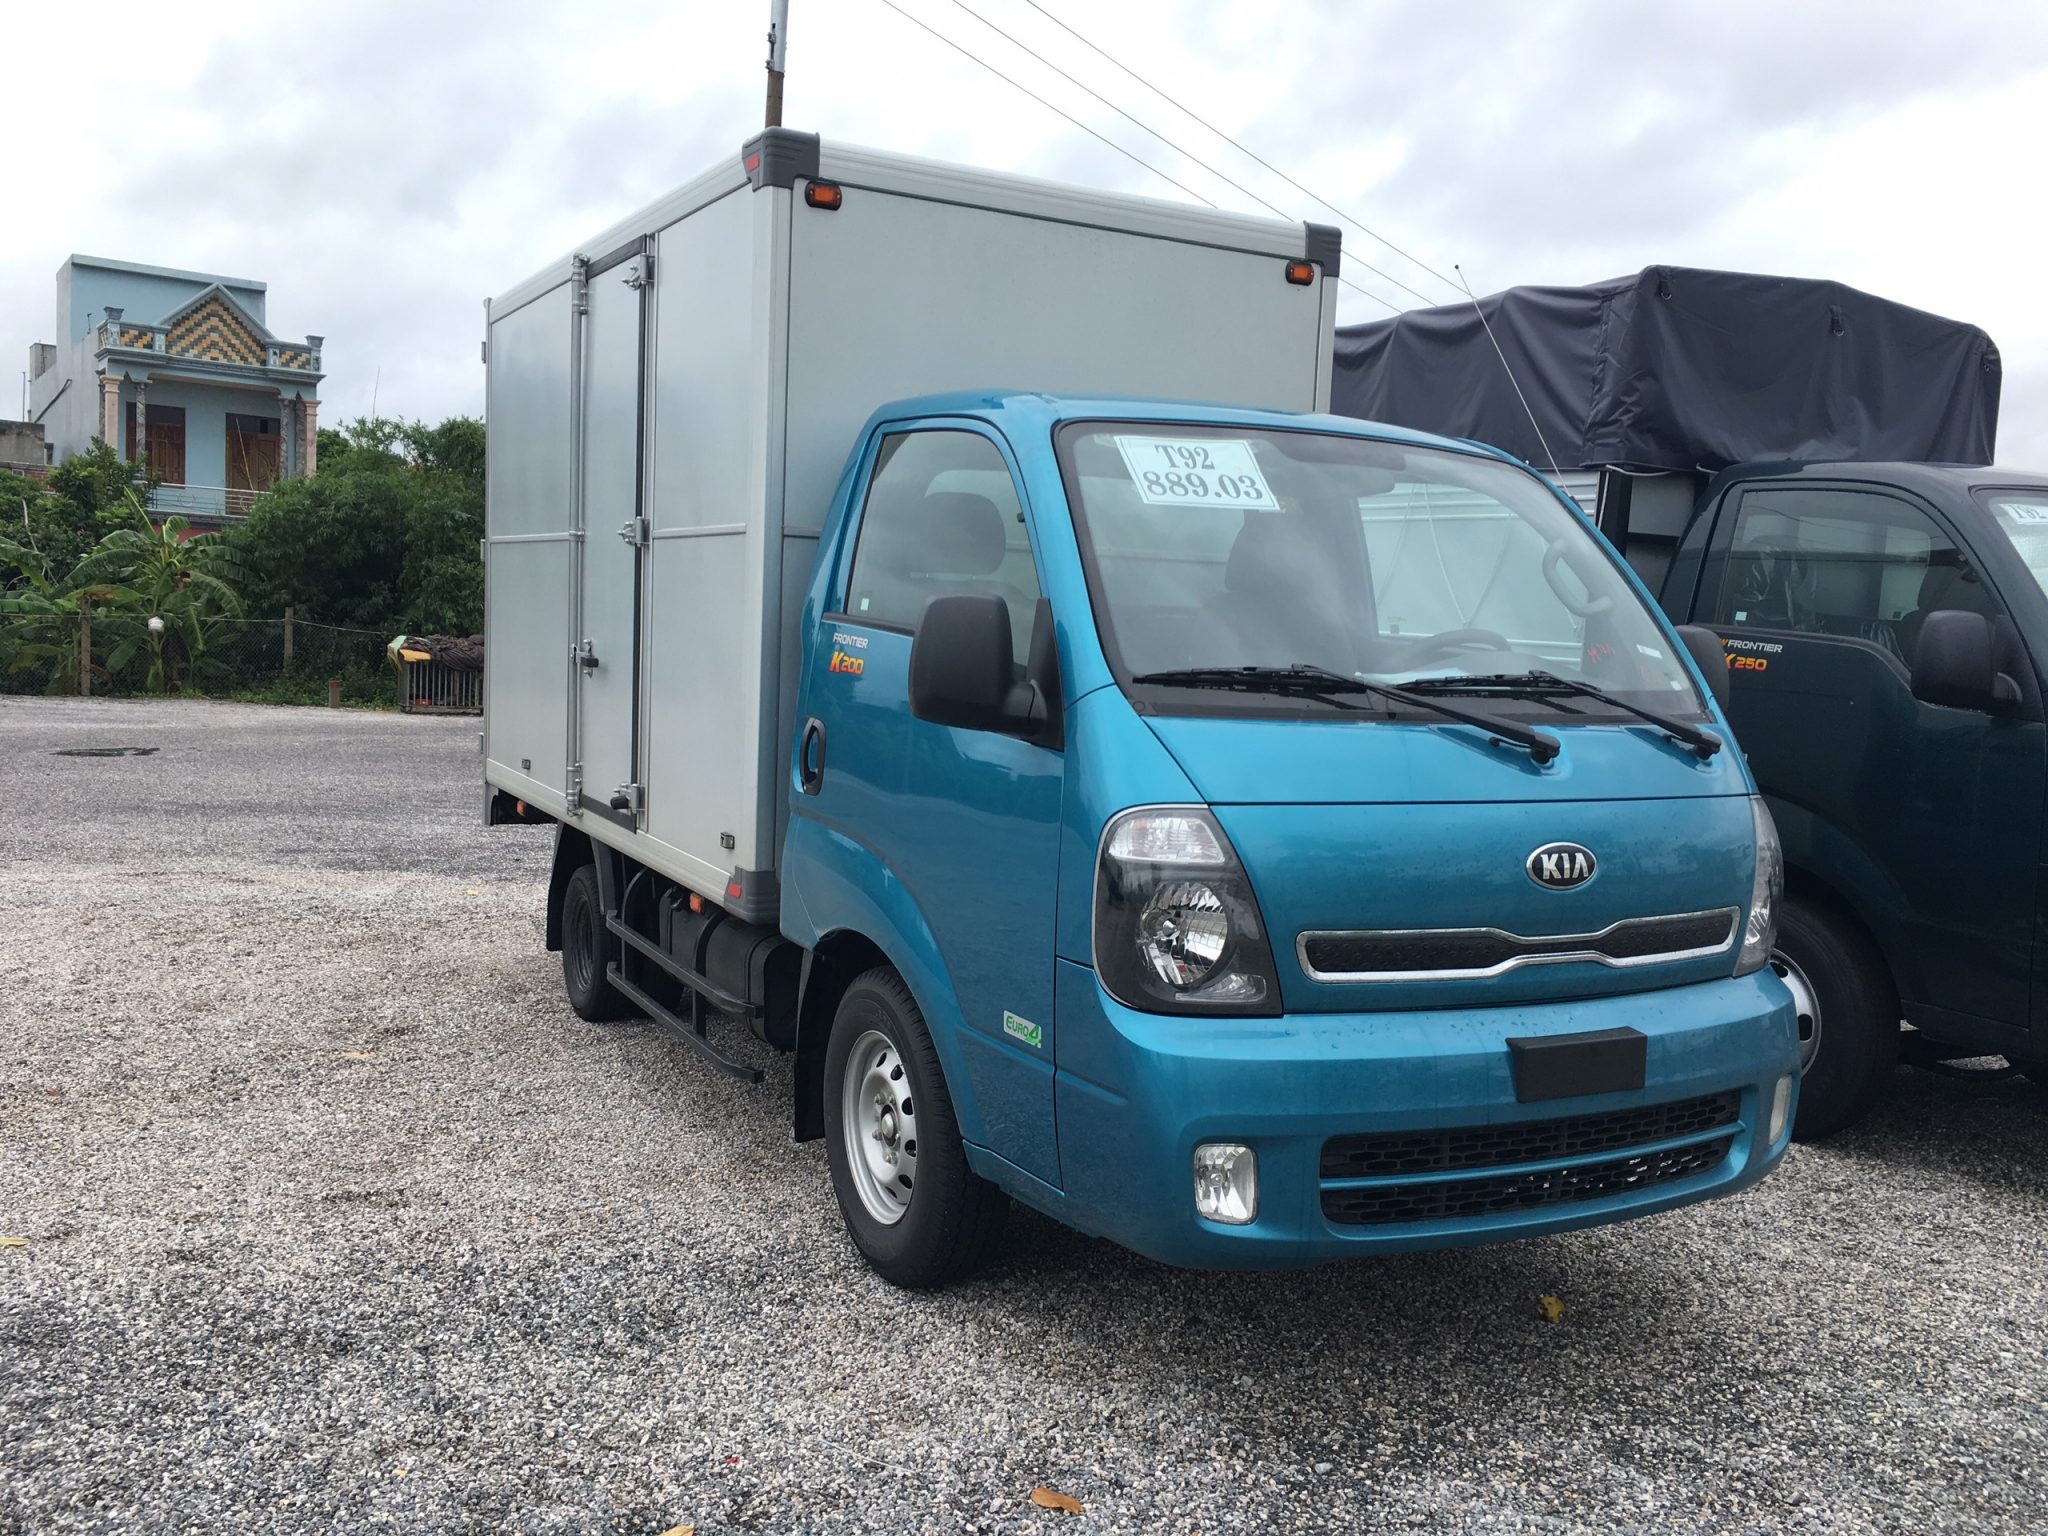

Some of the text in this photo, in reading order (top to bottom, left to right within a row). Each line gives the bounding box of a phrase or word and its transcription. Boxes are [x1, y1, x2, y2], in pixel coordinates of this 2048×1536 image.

[1154, 444, 1216, 470] T92
[1142, 470, 1264, 500] 889.03
[832, 632, 869, 649] FRONTIER
[1727, 639, 1783, 653] FRONTIER
[829, 651, 864, 675] K200
[1540, 852, 1589, 880] KIA
